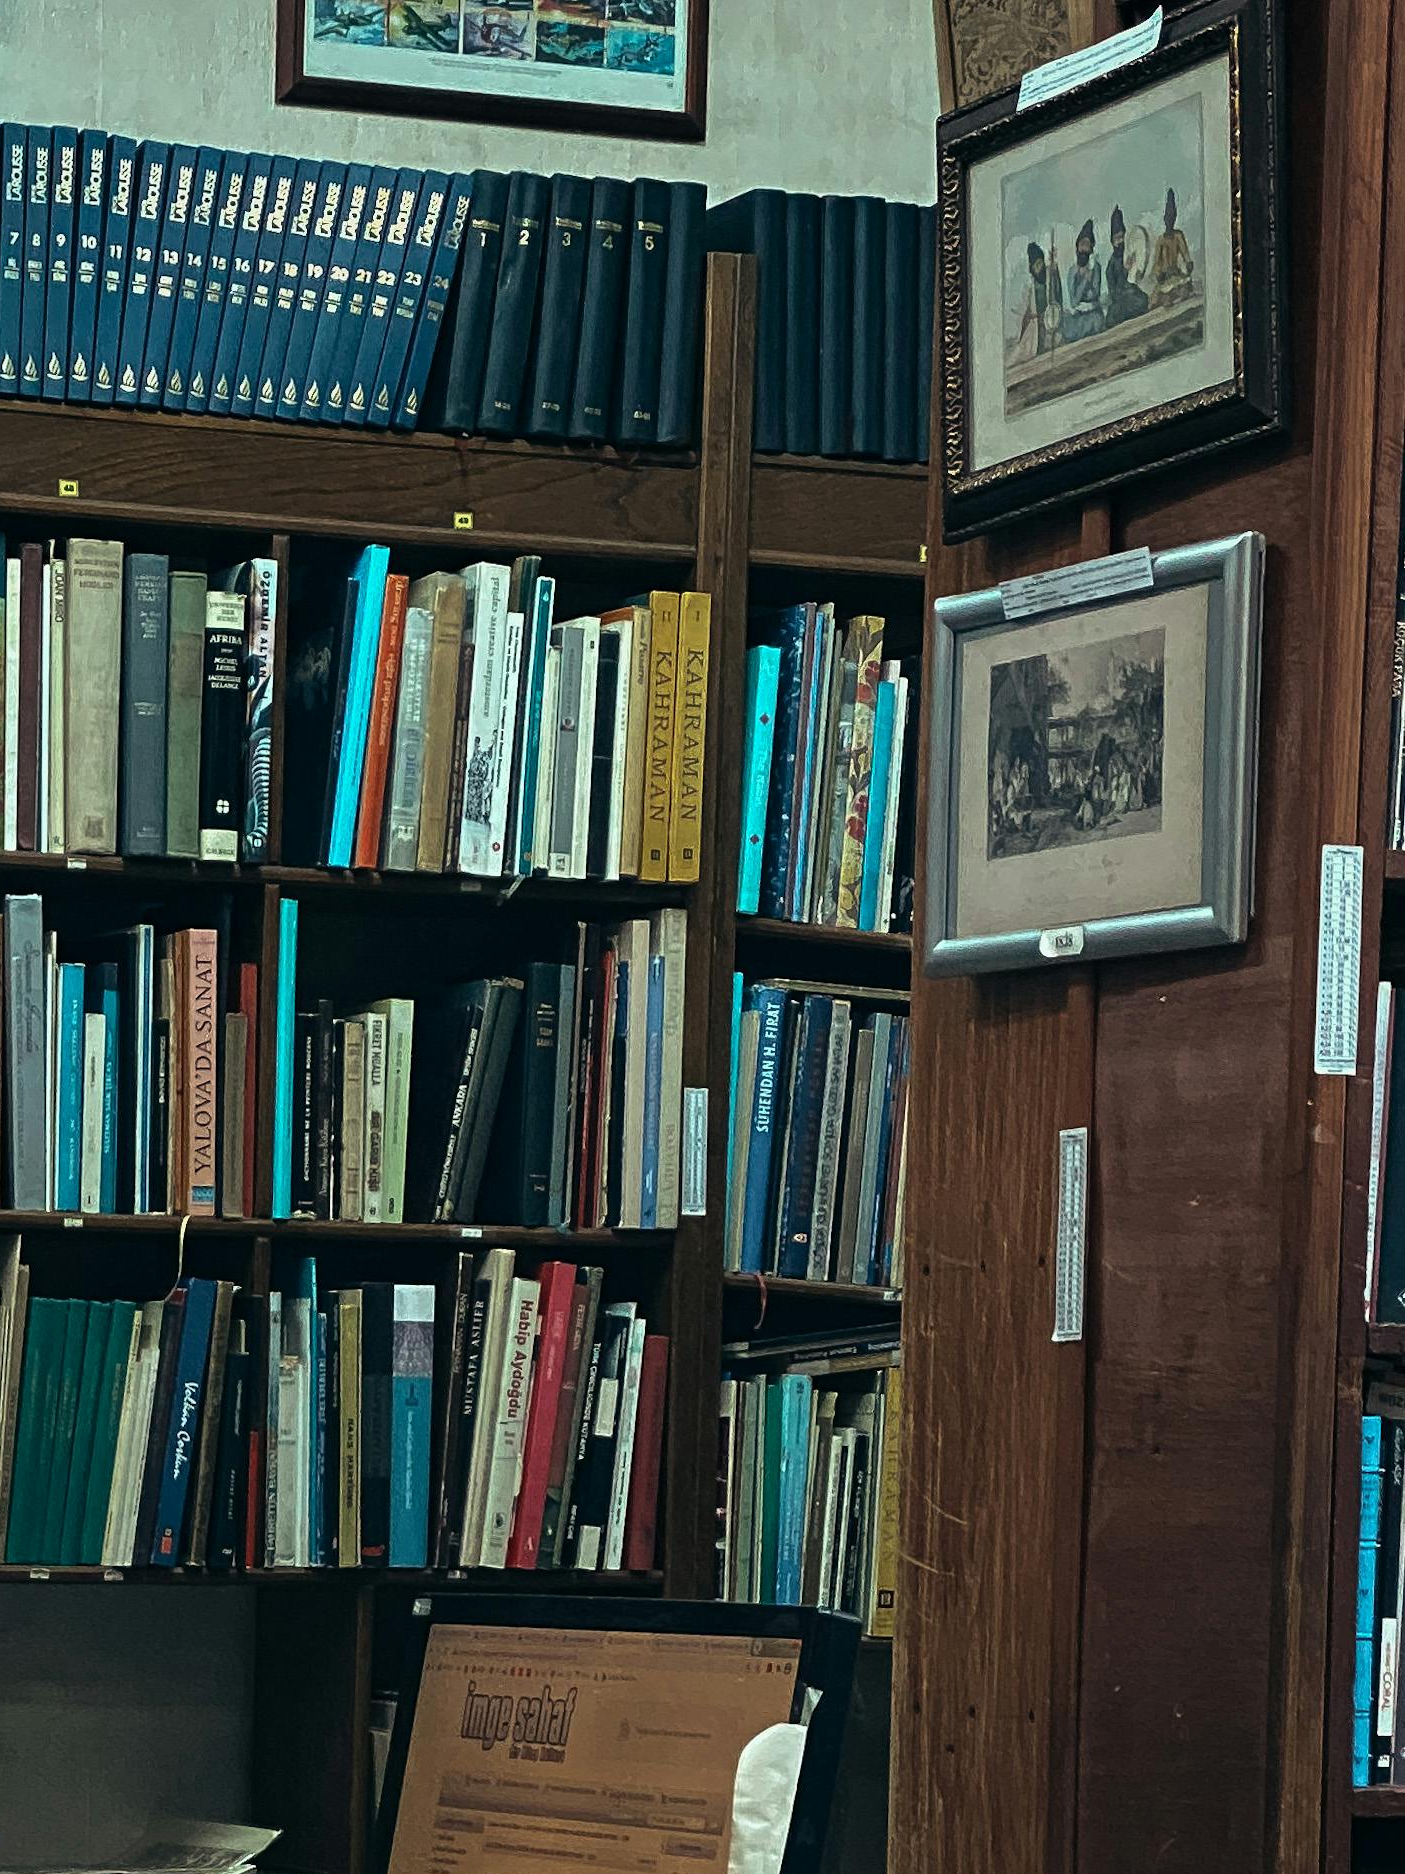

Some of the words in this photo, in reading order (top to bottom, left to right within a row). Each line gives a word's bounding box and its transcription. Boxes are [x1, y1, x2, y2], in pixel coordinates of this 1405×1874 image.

[12, 144, 23, 201] LAROUSSE
[35, 147, 48, 203] LAROUSSE
[60, 147, 74, 203] LAROUSSE
[89, 149, 103, 205] LAROUSSE
[144, 163, 163, 219] LAROUSSE
[10, 232, 20, 245] 7
[32, 233, 41, 247] 8
[56, 233, 65, 247] 9
[81, 235, 97, 249] 10
[519, 230, 530, 247] 2
[562, 233, 571, 248] 3
[645, 235, 654, 251] 5
[109, 245, 122, 259] 11
[135, 247, 152, 262] 12
[163, 249, 179, 265] 13
[187, 252, 202, 267] 14
[212, 255, 227, 271] 15
[235, 258, 250, 272] 16
[258, 259, 275, 274] 17
[283, 262, 298, 277] 18
[306, 264, 323, 278] 19
[331, 265, 349, 282] 20
[355, 269, 371, 284] 21
[377, 270, 395, 286] 22
[404, 271, 422, 286] 23
[257, 637, 269, 678] ALTAN
[648, 650, 674, 822] KAHRAMAN
[680, 648, 704, 820] KAHRAMAN
[194, 954, 214, 1032] SANAT
[763, 1002, 780, 1038] FIRAT
[762, 1042, 776, 1056] H.
[192, 1040, 213, 1173] YALOVA'DA
[450, 1083, 468, 1127] ANKARA
[514, 1299, 533, 1346] Habip
[460, 1353, 479, 1416] MUSTAFA
[504, 1349, 528, 1419] Aydoğdu
